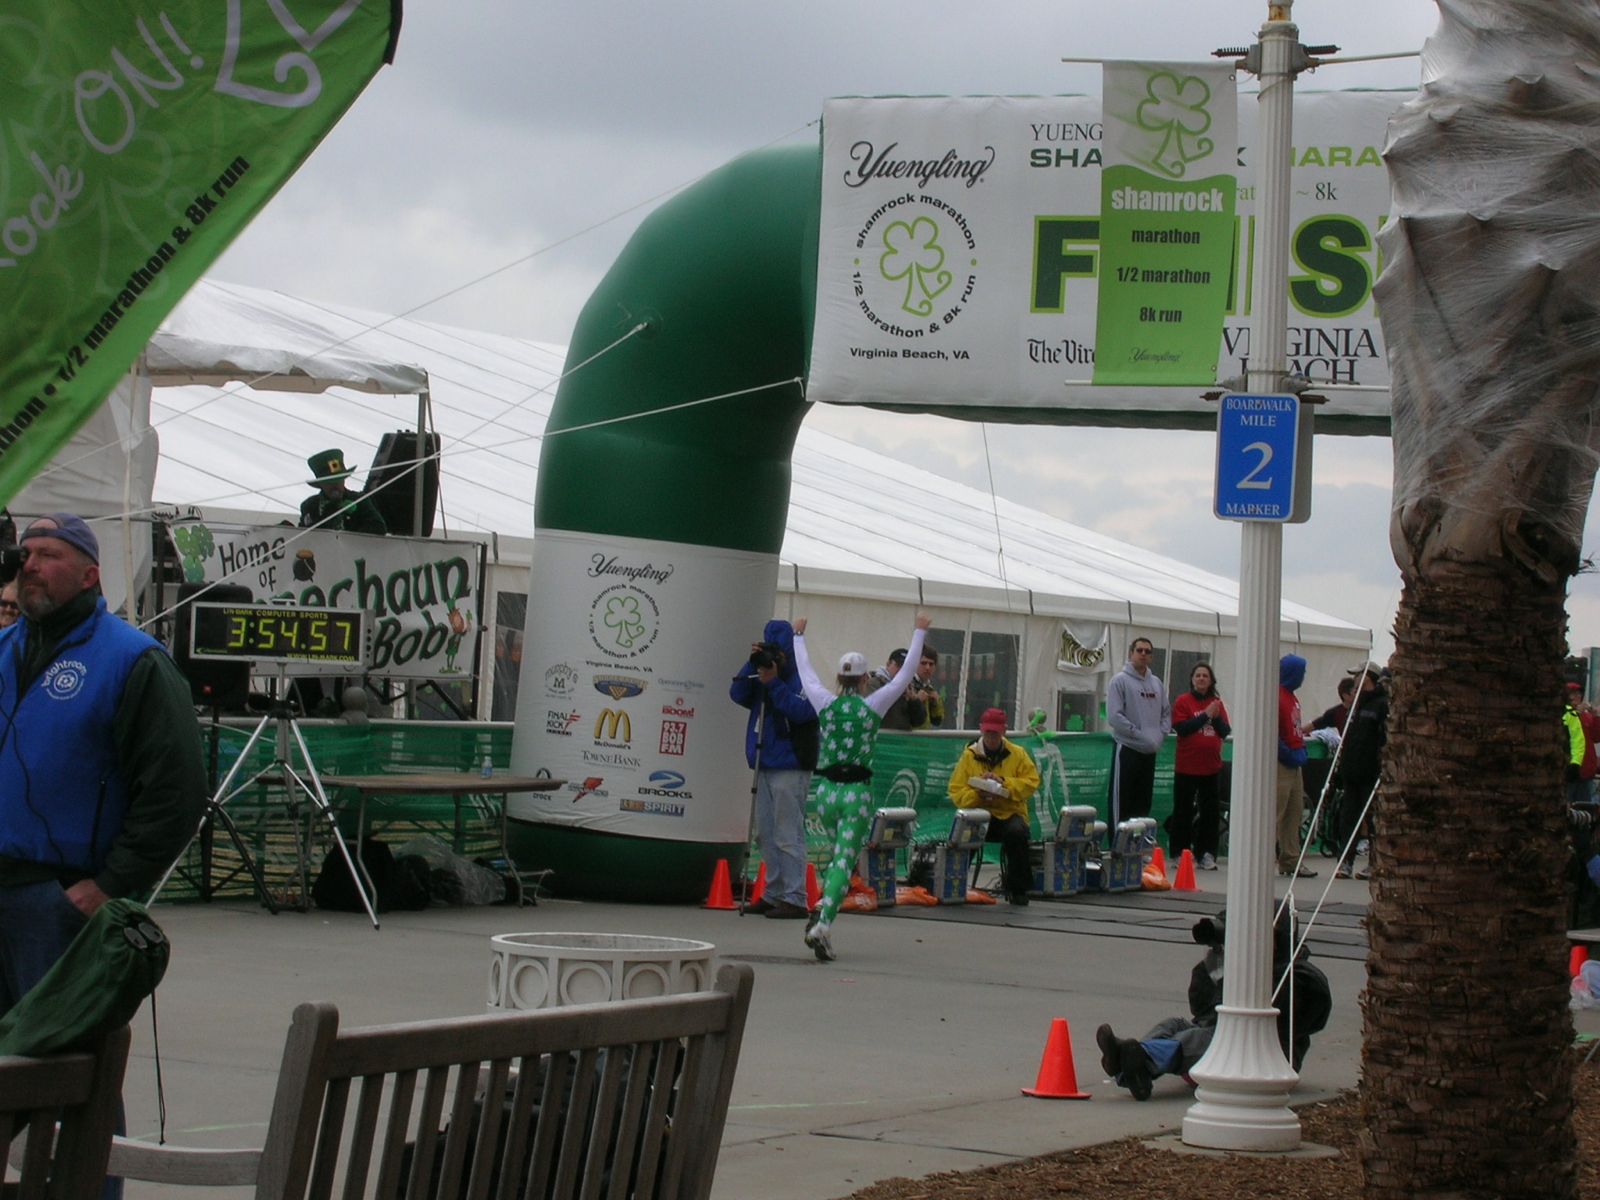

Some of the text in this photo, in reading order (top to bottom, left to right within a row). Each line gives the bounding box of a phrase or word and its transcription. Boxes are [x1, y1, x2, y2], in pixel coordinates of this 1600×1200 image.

[844, 140, 996, 188] Yuengling
[1111, 186, 1224, 212] shamrock
[1315, 182, 1338, 201] 8k
[856, 193, 976, 250] shamrock marathon
[1131, 229, 1201, 244] marathon
[83, 240, 176, 352] marathon
[171, 215, 193, 246] &
[184, 192, 218, 228] 8k
[211, 155, 251, 199] run
[1116, 266, 1210, 284] 1/2 marathon
[853, 271, 976, 338] 1/2 marathon & 8k run
[1139, 306, 1182, 323] 8k run
[1027, 338, 1061, 363] The
[1222, 327, 1380, 358] VIGINIA
[850, 348, 970, 360] Virginia Beach, VA
[1226, 399, 1292, 412] BOARDWALK
[1240, 414, 1277, 428] MILE
[1236, 441, 1274, 490] 2
[1226, 502, 1281, 516] MARKER
[218, 536, 286, 577] Home
[259, 566, 277, 591] of
[587, 553, 674, 585] Yuengling
[592, 583, 660, 616] shamrock marathon
[256, 609, 297, 618] COMPUTER
[299, 611, 329, 620] SPORTS
[366, 610, 449, 670] Bob
[592, 635, 628, 659] marathon
[585, 660, 612, 669] Virginia
[547, 710, 569, 721] FINAL
[663, 722, 685, 733] 93.7
[661, 743, 682, 754] FM
[662, 732, 684, 746] BOB
[638, 787, 693, 800] BROOKS
